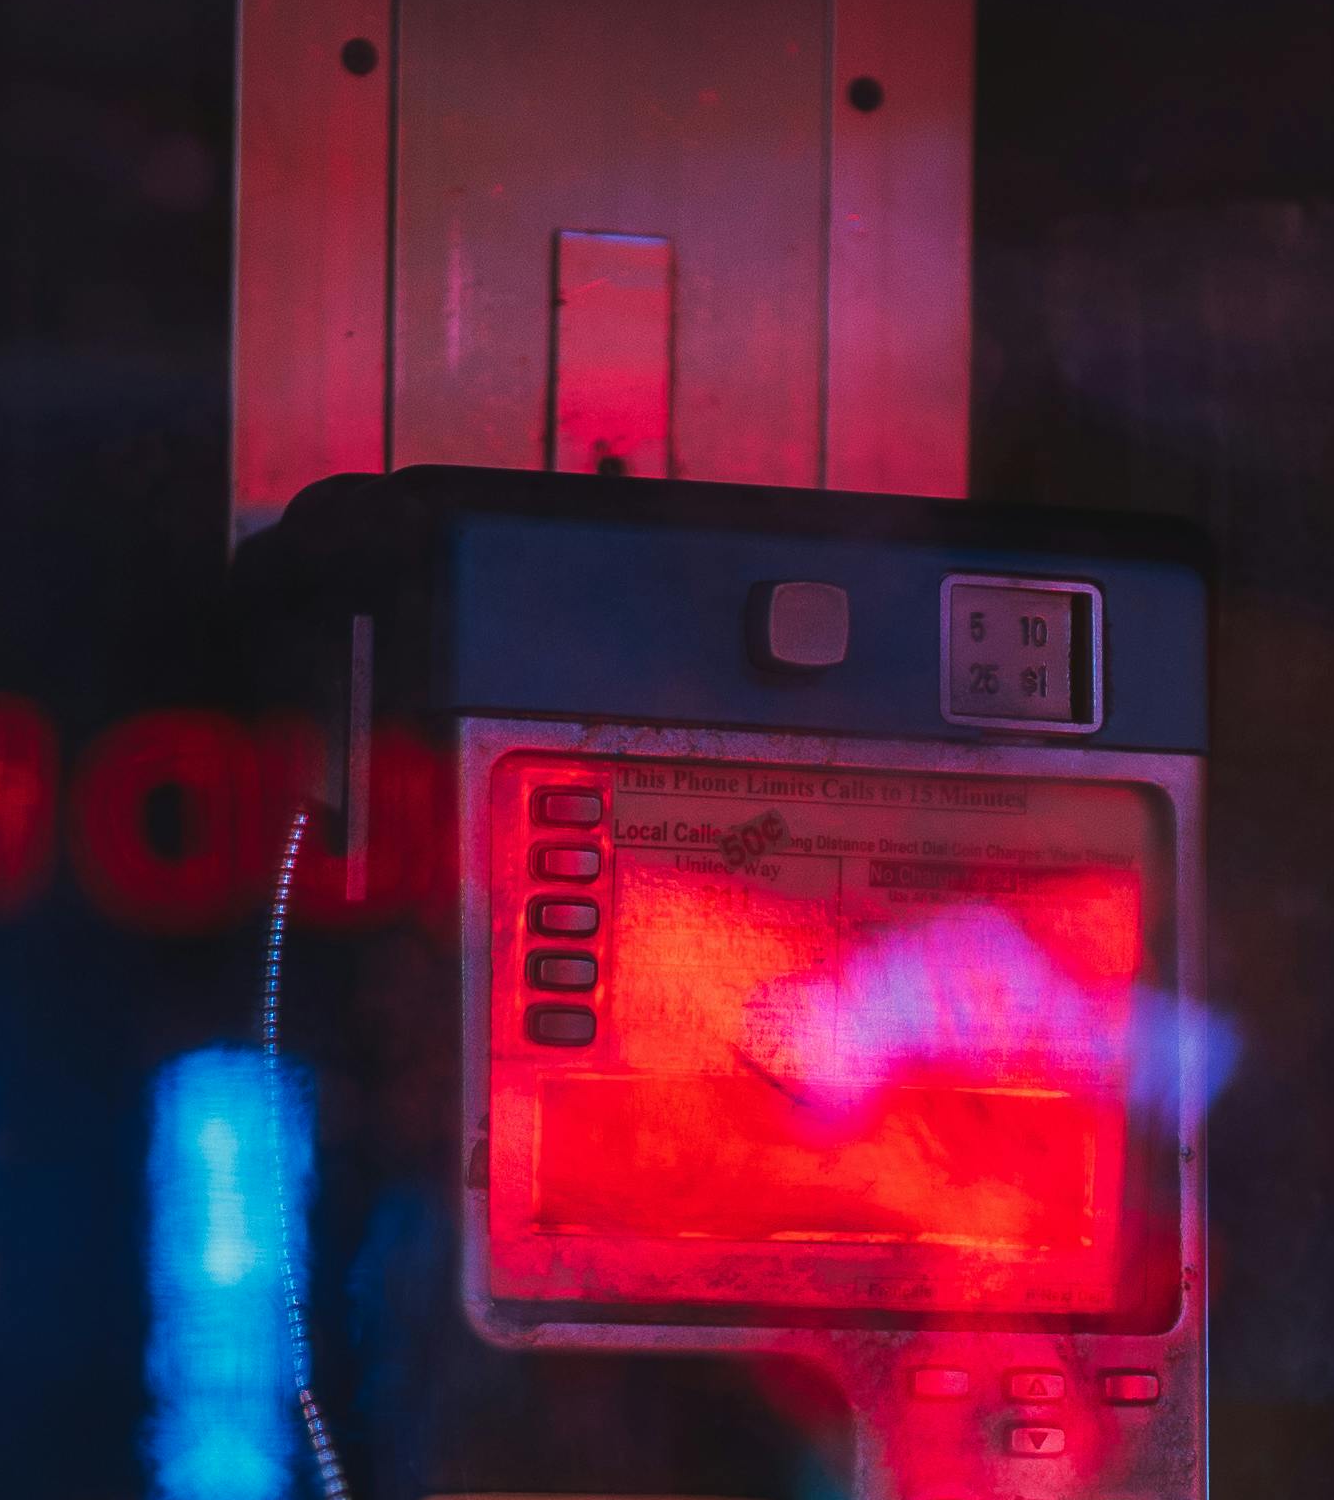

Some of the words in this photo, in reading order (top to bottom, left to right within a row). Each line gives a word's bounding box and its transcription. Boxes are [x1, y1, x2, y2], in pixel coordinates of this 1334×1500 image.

[970, 611, 986, 643] 5
[1020, 615, 1048, 648] 10
[970, 662, 1001, 695] 25
[1020, 664, 1048, 698] $1
[619, 766, 666, 789] This
[672, 769, 740, 793] Phone
[747, 773, 816, 798] Limits
[822, 778, 875, 801] Calls
[881, 783, 902, 801] to
[910, 783, 934, 803] 15
[940, 783, 1025, 808] Minutes
[614, 818, 669, 843] Local
[817, 834, 876, 853] Distance
[878, 838, 918, 855] Direct
[922, 840, 948, 856] Dial
[721, 812, 784, 867] 50¢
[744, 858, 783, 882] Way
[870, 864, 894, 883] No
